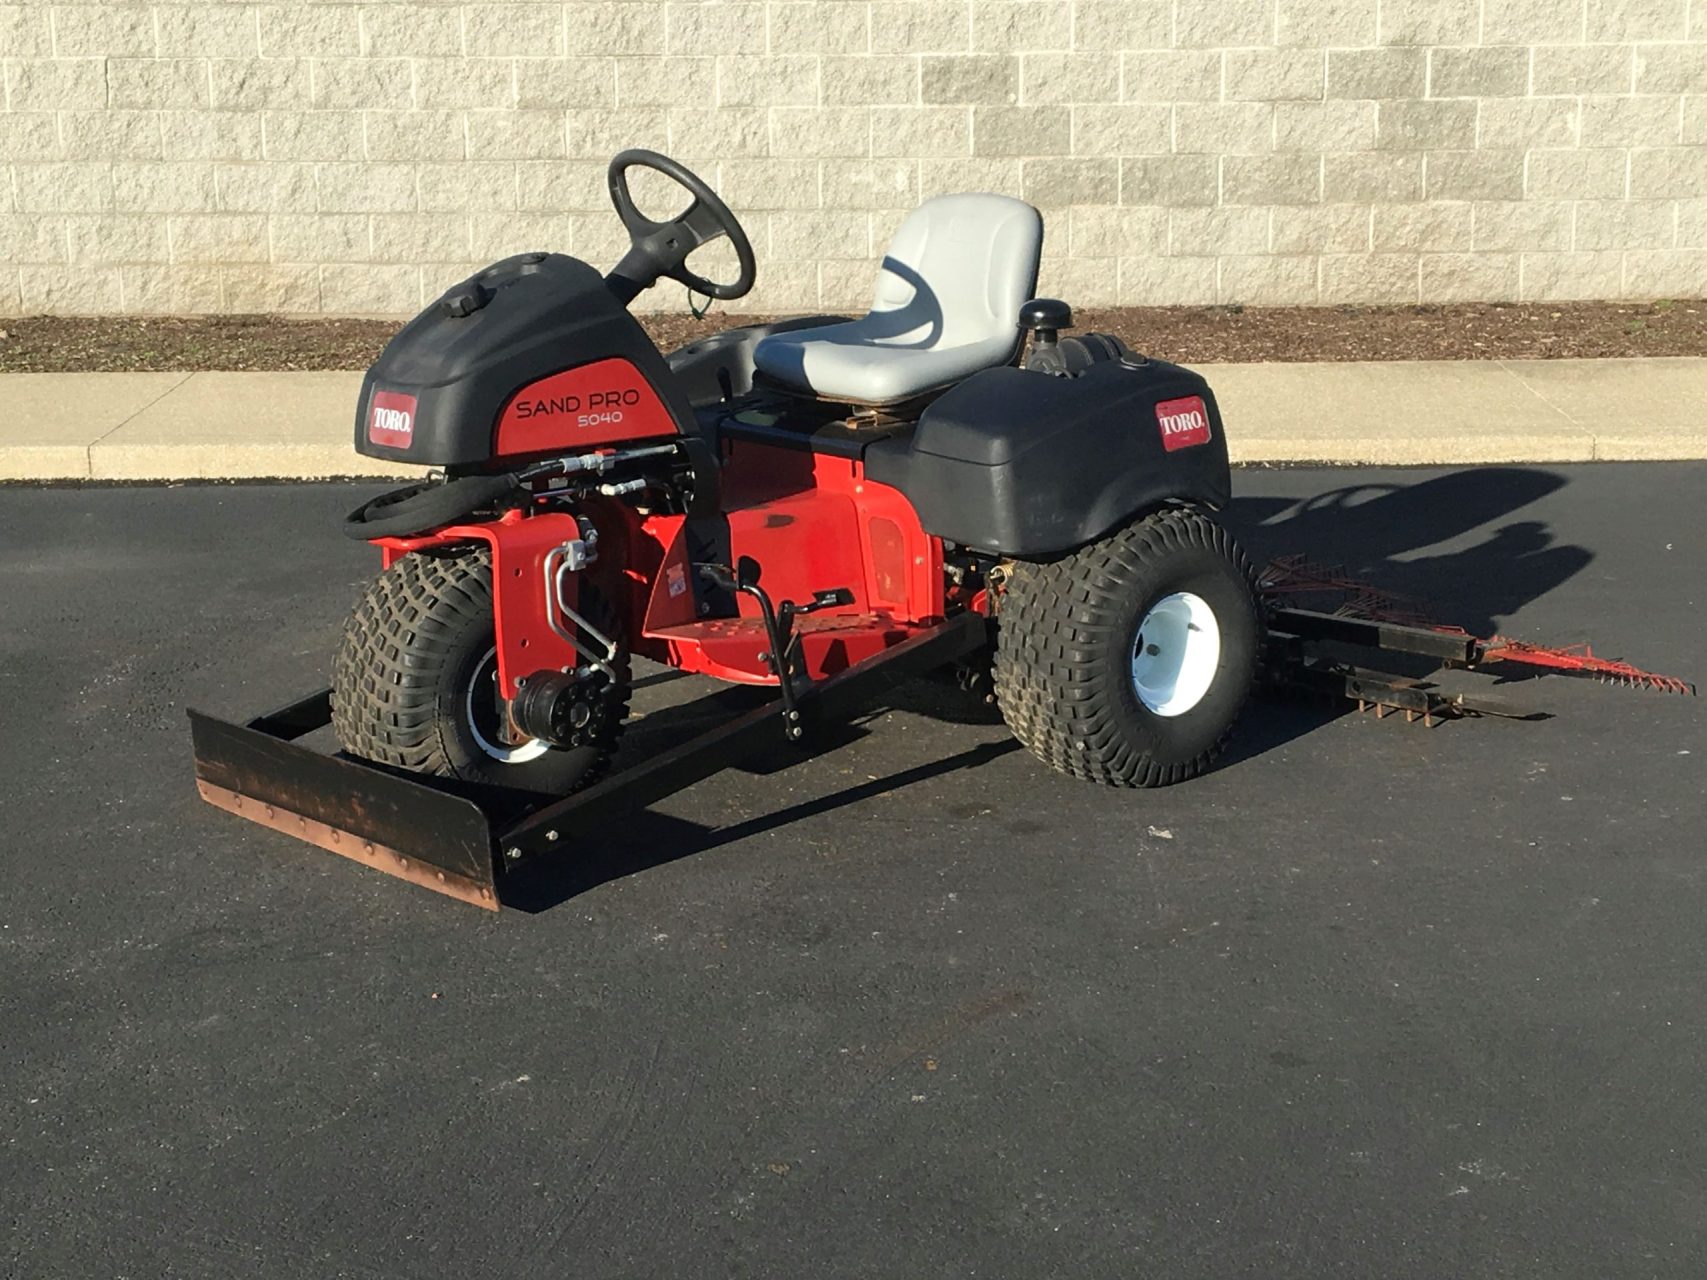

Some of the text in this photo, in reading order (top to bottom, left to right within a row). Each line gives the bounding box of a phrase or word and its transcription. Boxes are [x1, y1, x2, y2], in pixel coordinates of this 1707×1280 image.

[516, 389, 640, 419] SAND PRO
[577, 411, 623, 427] 5040
